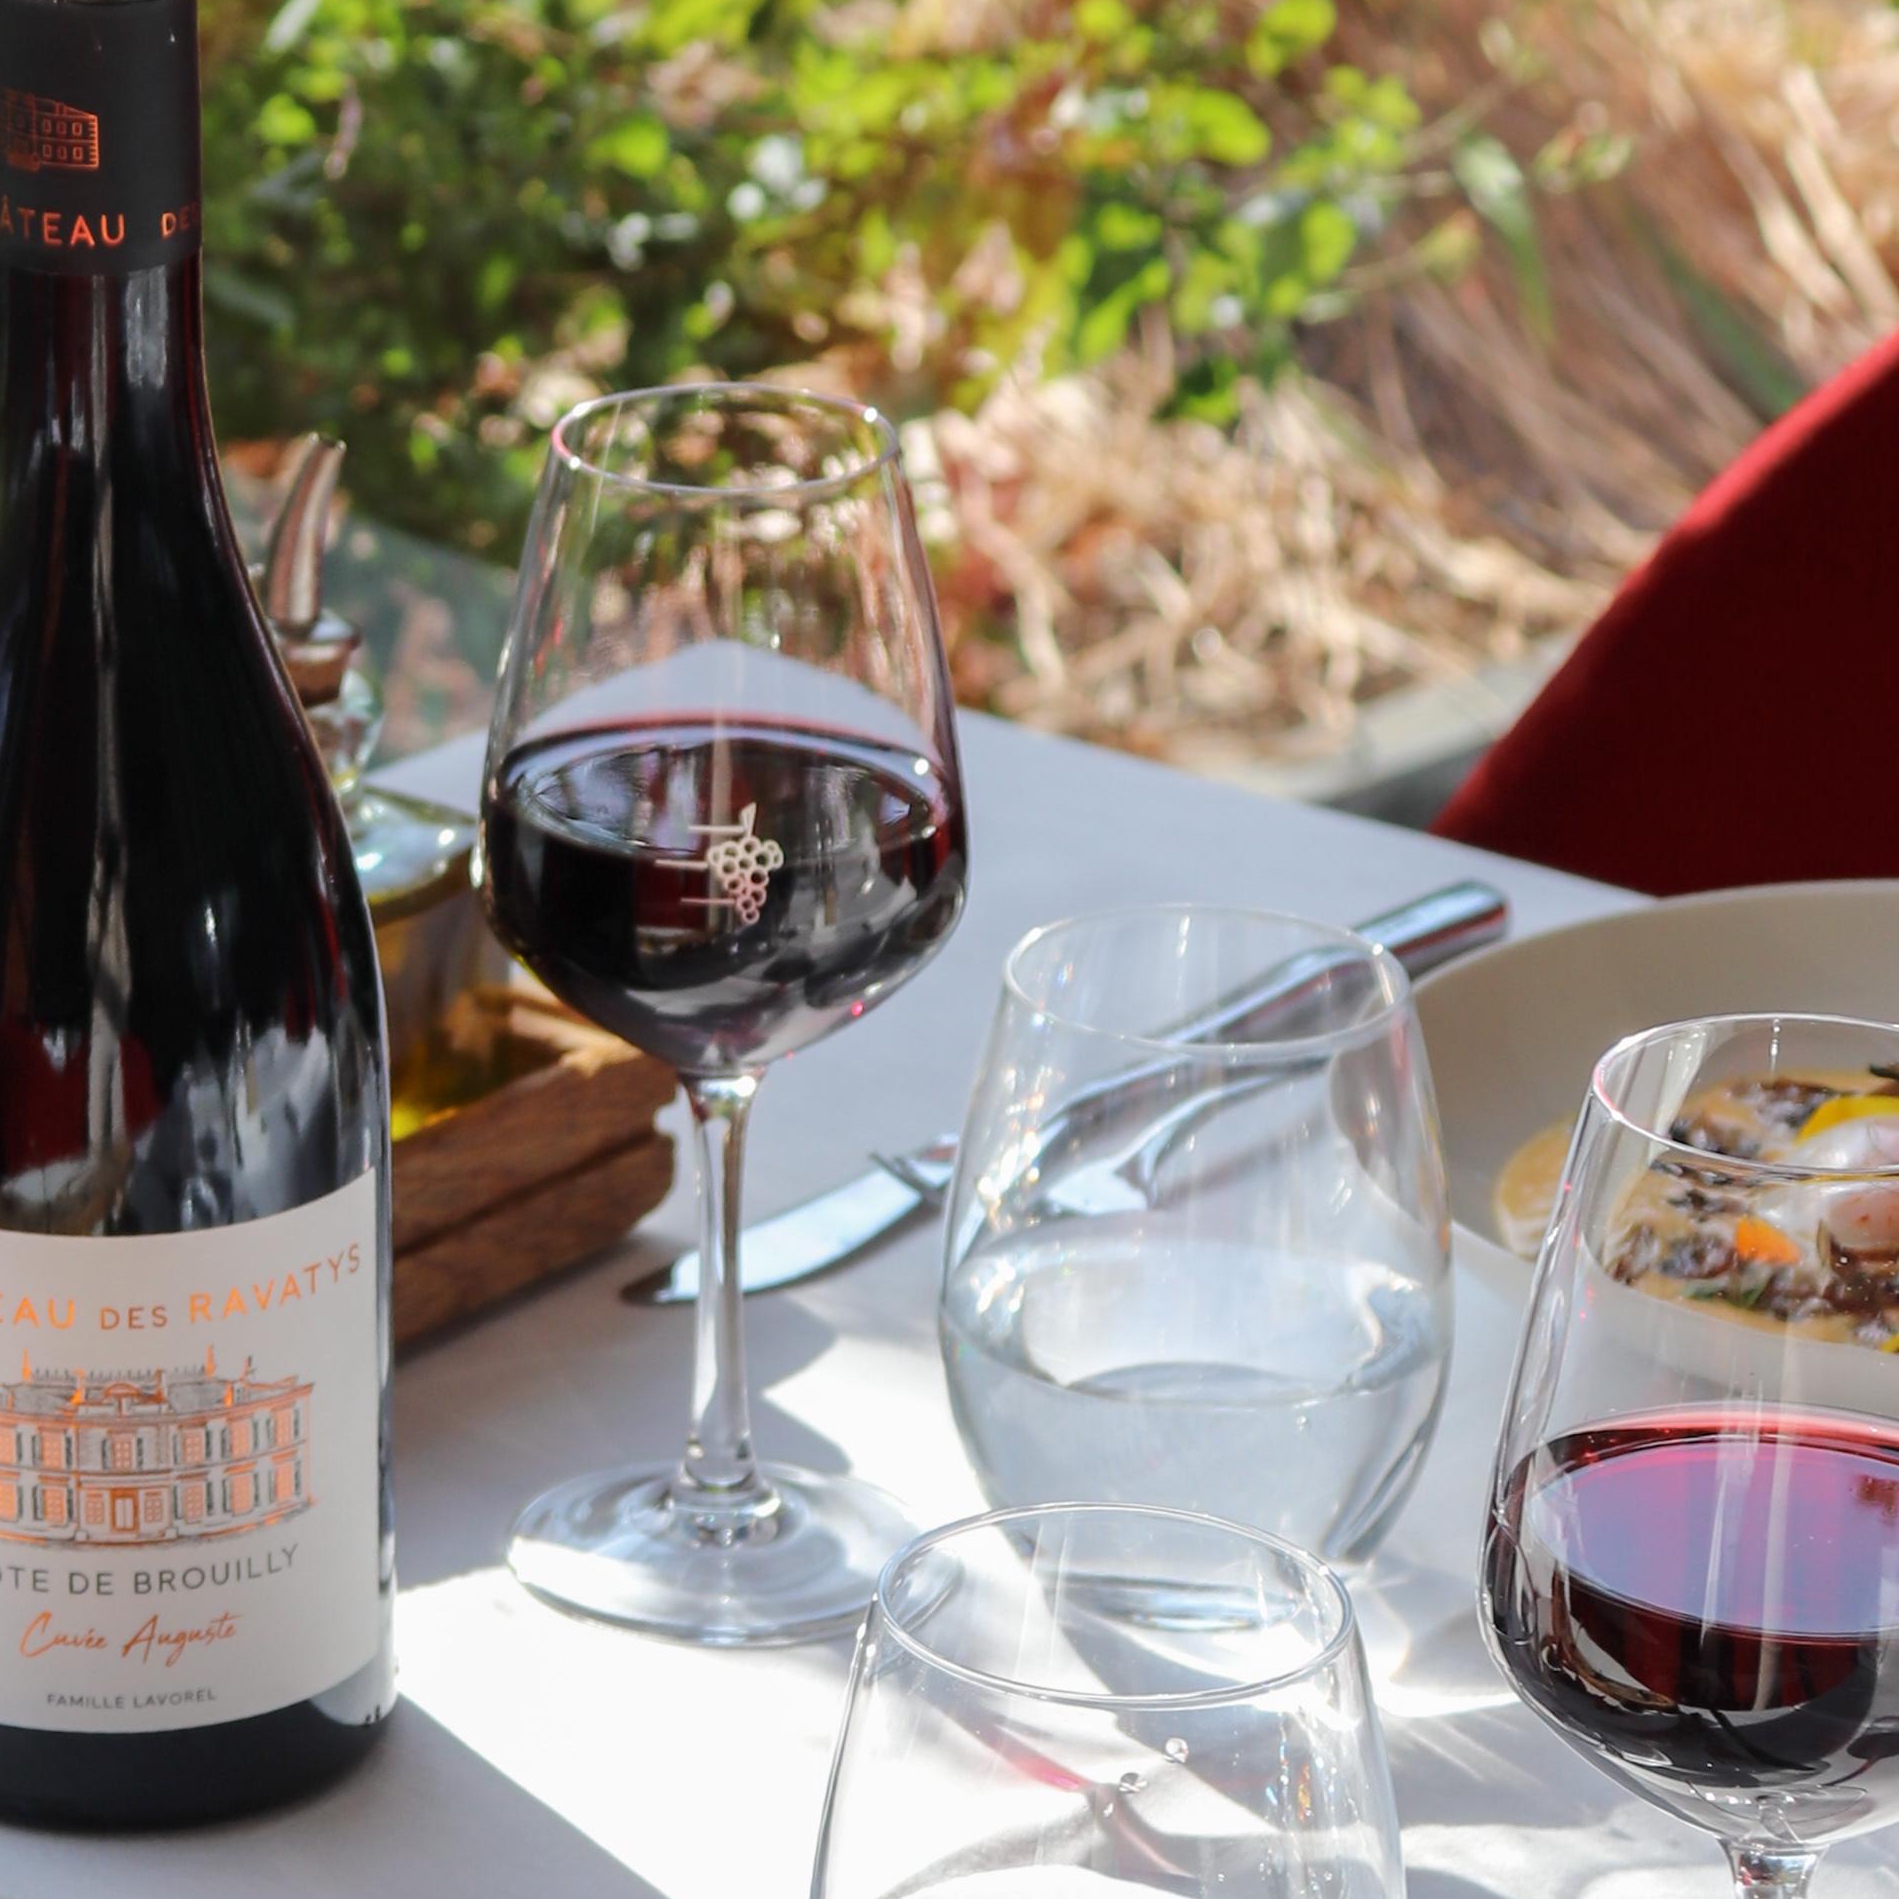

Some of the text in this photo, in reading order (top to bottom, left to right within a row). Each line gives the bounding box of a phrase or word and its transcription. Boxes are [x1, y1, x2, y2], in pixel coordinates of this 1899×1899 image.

[99, 1305, 169, 1330] DES
[189, 1243, 361, 1324] RAVATYS
[68, 1571, 114, 1596] DE
[133, 1543, 299, 1596] BROUILLY
[19, 1610, 244, 1668] Cuvée Auguste
[46, 1686, 218, 1710] FAMILLE LAVOREL
